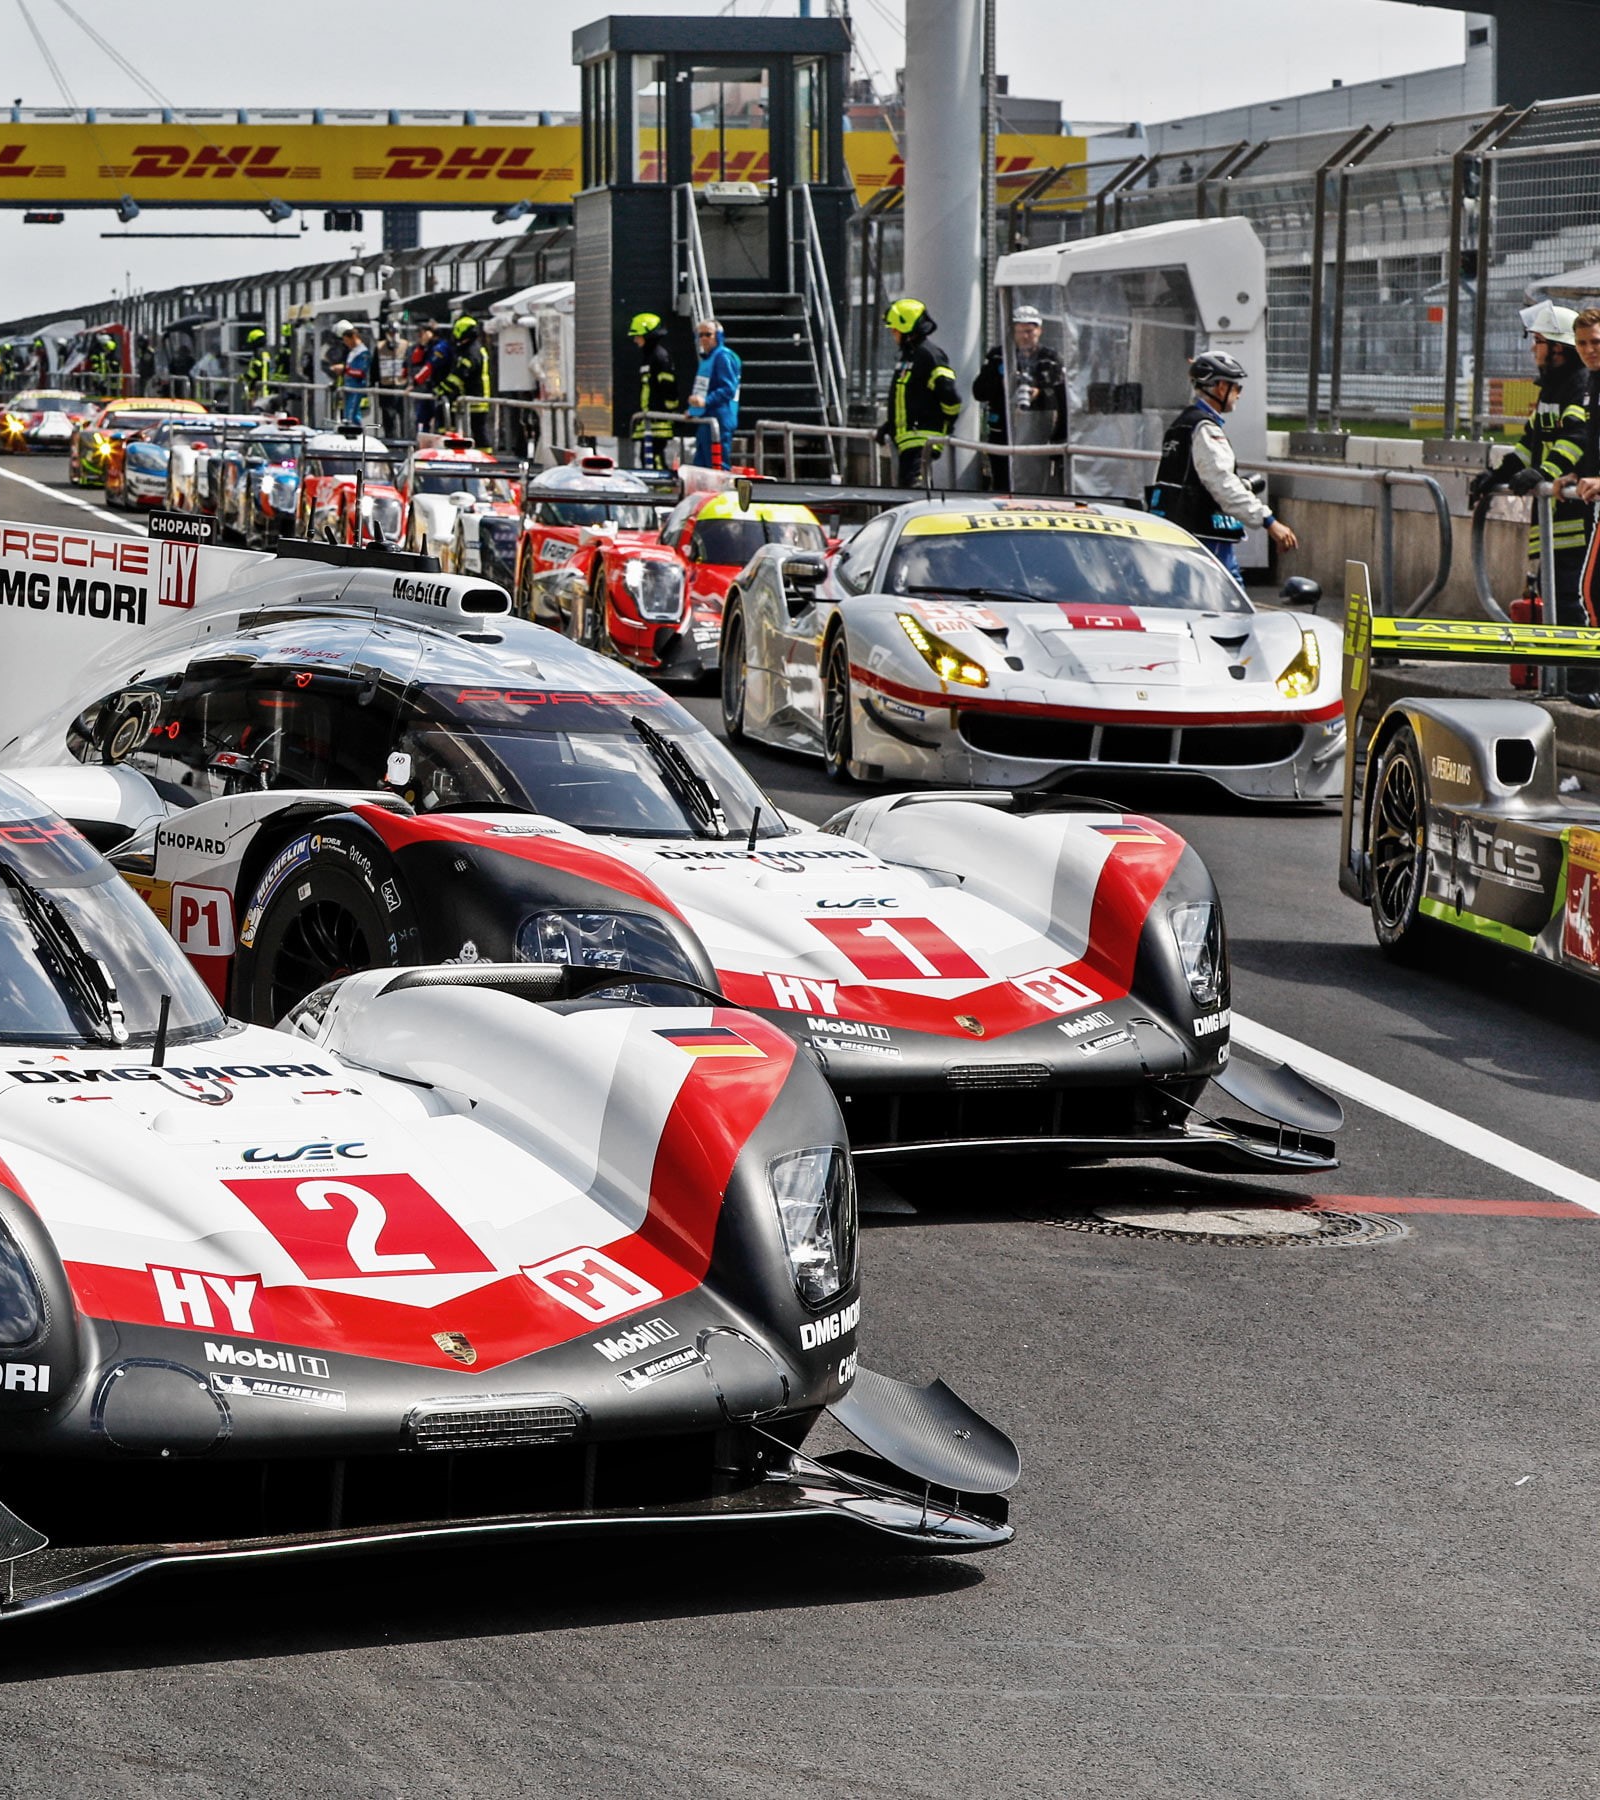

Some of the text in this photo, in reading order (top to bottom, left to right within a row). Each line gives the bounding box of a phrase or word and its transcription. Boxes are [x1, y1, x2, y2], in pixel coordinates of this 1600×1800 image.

[129, 145, 292, 179] DHL
[385, 146, 544, 180] DHL
[150, 516, 212, 537] CHOPARD
[962, 514, 1142, 537] Ferrari
[160, 542, 198, 606] HY
[55, 570, 148, 625] MORI
[393, 577, 434, 605] Mobil
[935, 620, 969, 633] AM
[1417, 622, 1549, 638] ASSET
[157, 830, 226, 856] CHOPARD
[654, 847, 871, 861] DMG MORI
[1473, 828, 1542, 882] TCS
[256, 839, 308, 904] MICHELIN
[815, 897, 900, 909] WEC
[179, 895, 221, 947] P1
[857, 918, 939, 977] 1
[766, 973, 840, 1015] HY
[1029, 975, 1079, 1006] P1
[806, 1016, 868, 1038] Mobil
[1058, 1015, 1095, 1038] Mobil
[1193, 1012, 1220, 1037] DMG
[839, 1040, 900, 1057] MICHELIN
[1095, 1031, 1129, 1050] MICHELIN
[5, 1063, 334, 1083] DMG MORI
[241, 1142, 369, 1163] WEC
[295, 1180, 437, 1274] 2
[543, 1259, 643, 1311] P1
[151, 1268, 258, 1334] HY
[800, 1296, 861, 1351] DMG MOR
[203, 1341, 296, 1374] Mobil
[593, 1325, 656, 1363] Mobil
[643, 1350, 699, 1378] MICHELIN
[252, 1381, 343, 1403] MICHELIN
